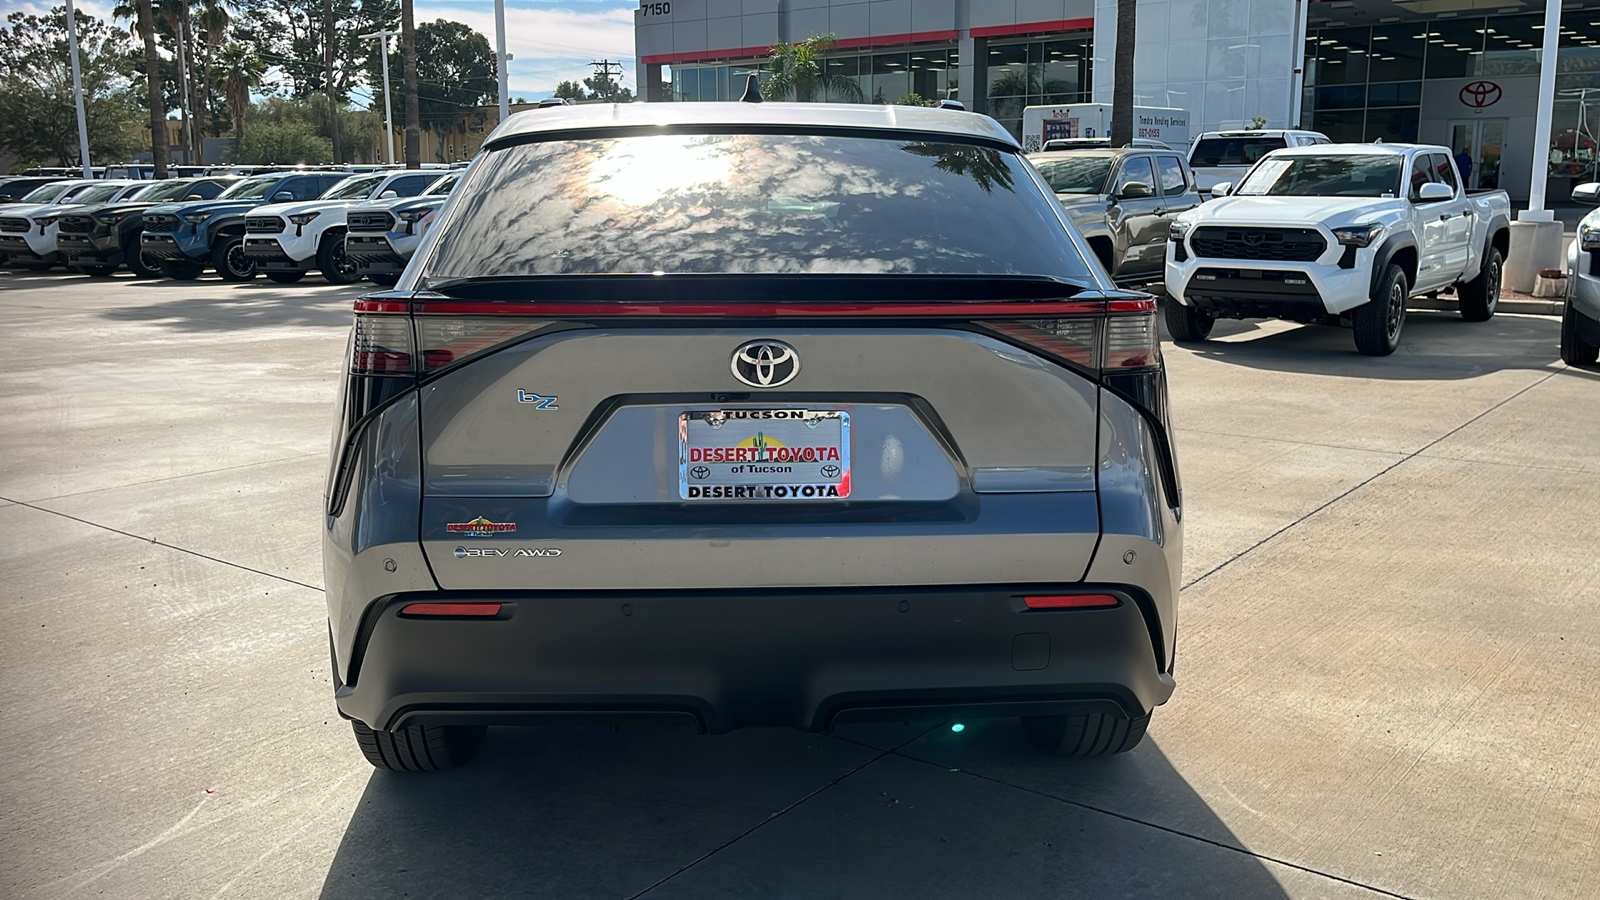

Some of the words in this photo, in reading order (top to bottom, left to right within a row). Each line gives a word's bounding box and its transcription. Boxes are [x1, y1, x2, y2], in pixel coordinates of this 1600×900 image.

[642, 2, 670, 16] 7150
[1170, 117, 1186, 127] Services
[723, 411, 804, 419] TUCSON
[690, 448, 759, 462] DESERT
[763, 447, 840, 462] TOYOTA
[731, 465, 746, 473] of
[747, 465, 792, 474] Tucson
[688, 486, 756, 498] DESERT
[764, 485, 840, 498] TOYOTA
[447, 524, 478, 532] DESERT
[482, 523, 516, 531] TOYOTA
[513, 547, 563, 557] AWD
